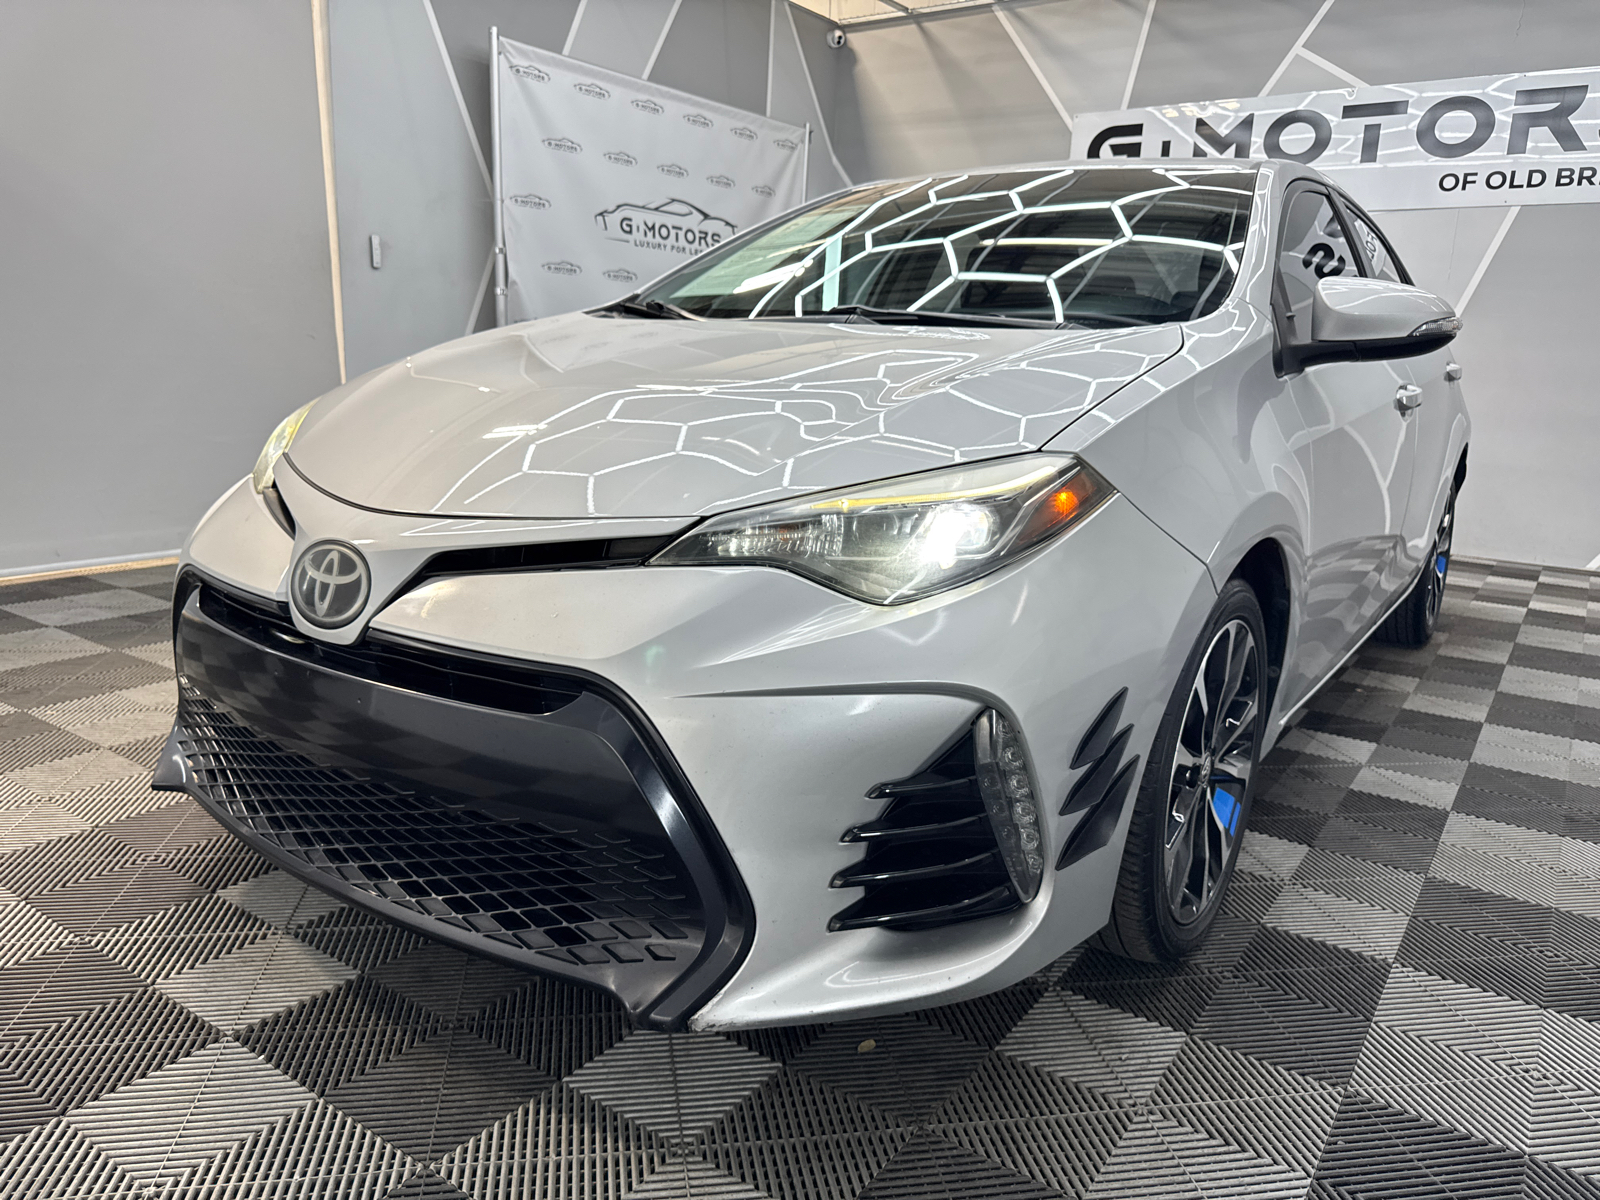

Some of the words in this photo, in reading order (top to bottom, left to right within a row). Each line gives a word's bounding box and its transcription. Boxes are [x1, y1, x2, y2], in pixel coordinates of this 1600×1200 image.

[1191, 85, 1600, 165] MOTOR
[1438, 172, 1478, 192] OF
[1485, 169, 1547, 190] OLD
[1554, 166, 1600, 188] BR
[643, 219, 722, 247] MOTORS
[634, 239, 667, 252] LUXURY
[670, 245, 687, 255] FOR
